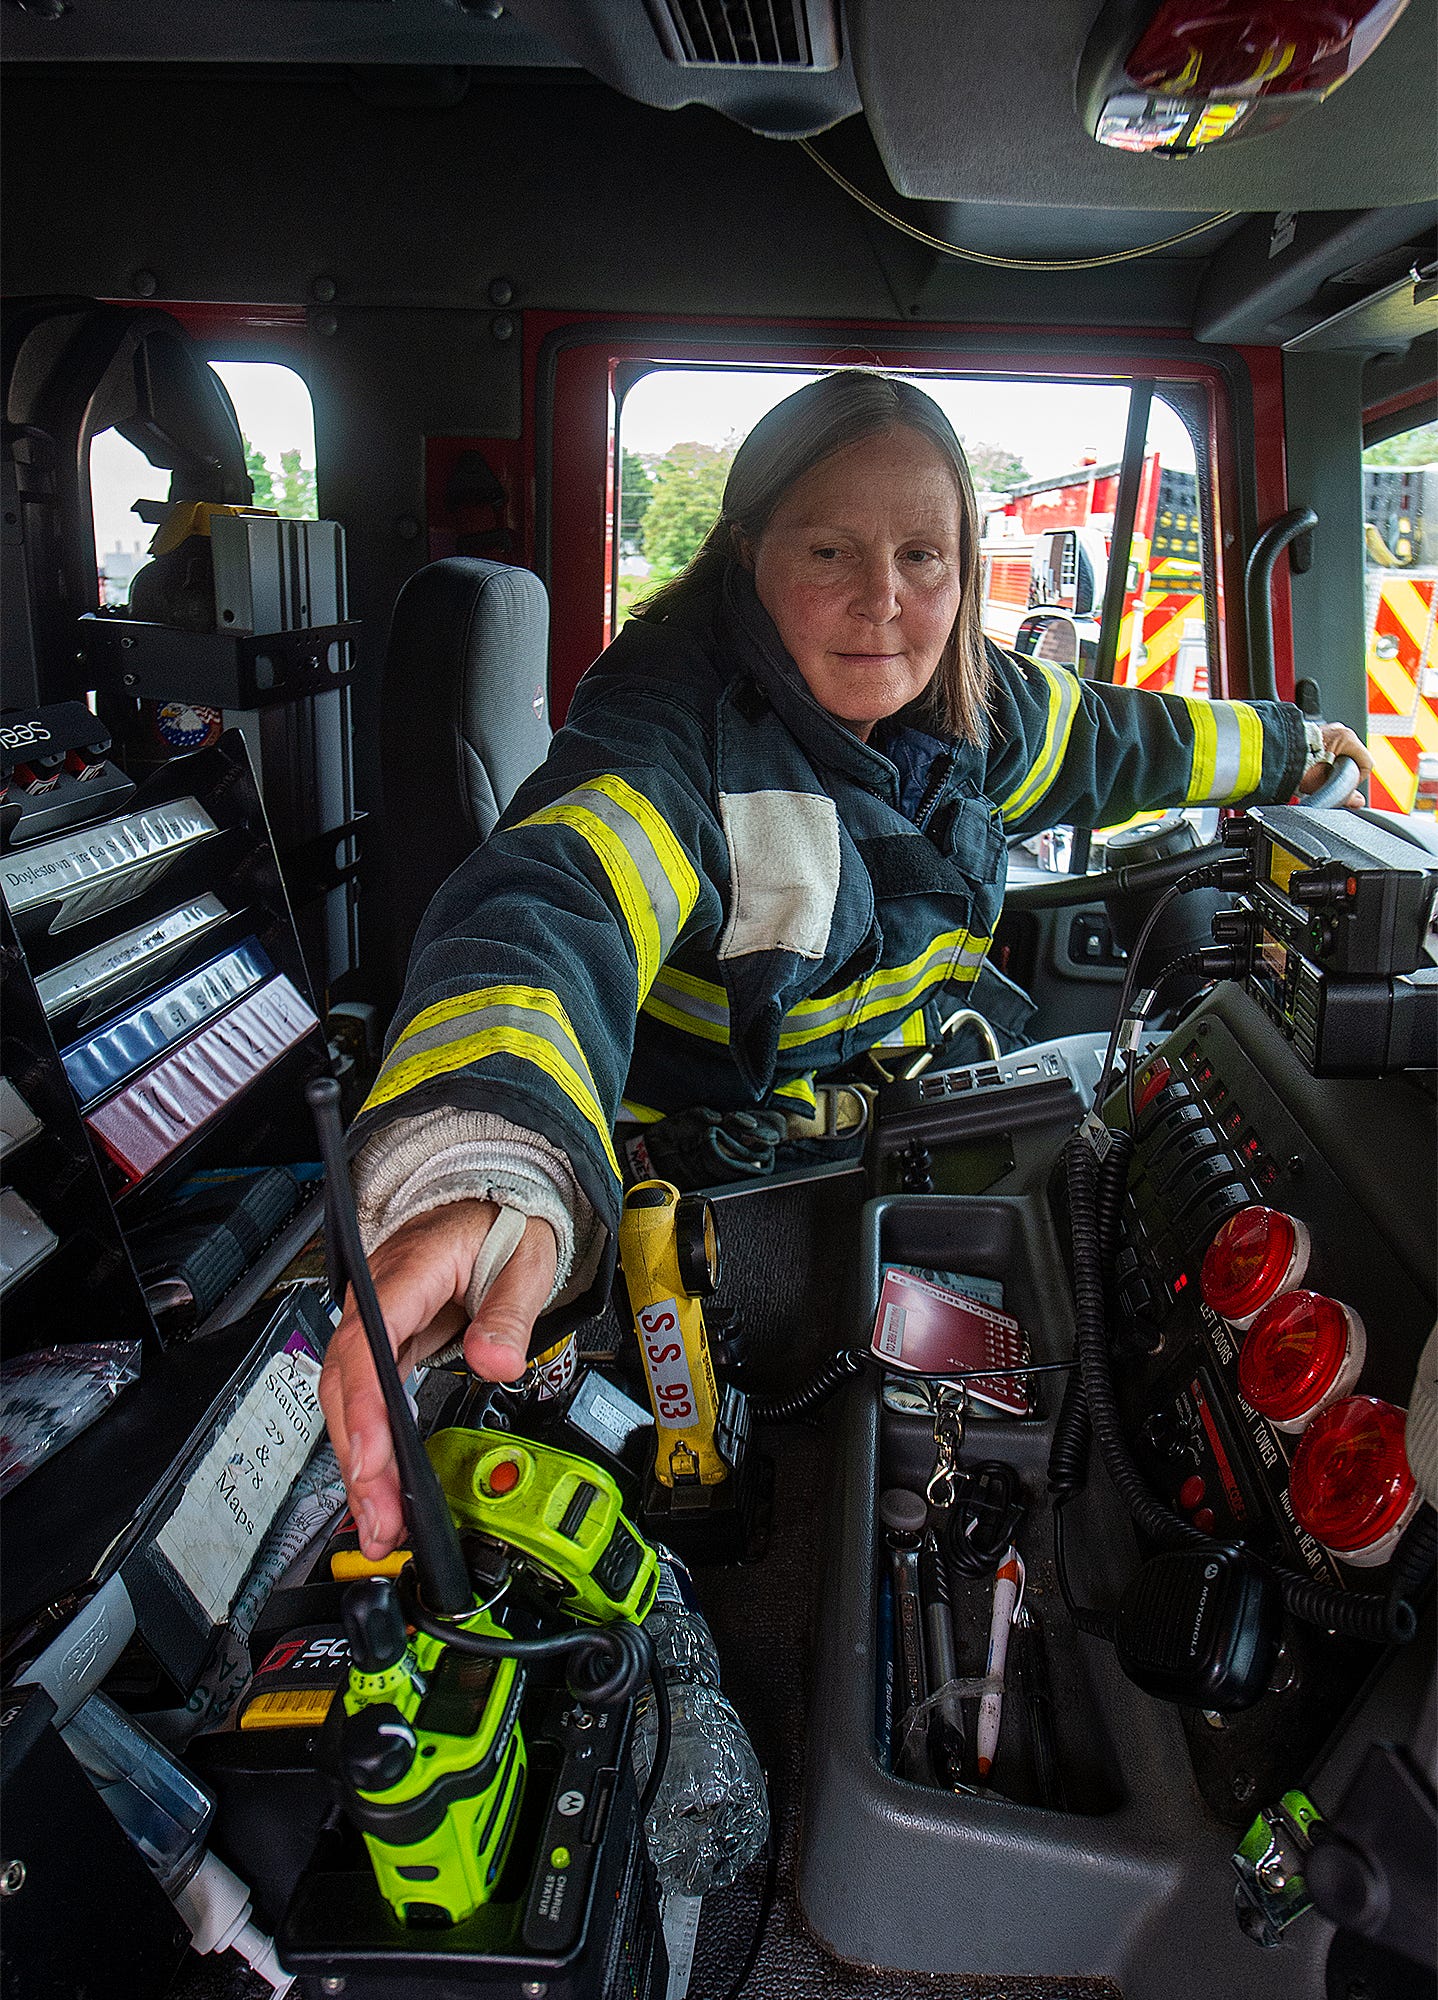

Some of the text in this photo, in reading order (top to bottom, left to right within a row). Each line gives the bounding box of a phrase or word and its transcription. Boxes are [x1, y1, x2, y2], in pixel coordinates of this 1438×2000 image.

[6, 858, 71, 887] Doylestown
[170, 1008, 187, 1028] 15
[965, 1302, 1015, 1328] SPECIAL
[1199, 1302, 1234, 1367] LEFT DOORS
[280, 1364, 320, 1413] NEW
[641, 1310, 692, 1420] S.S. 93
[265, 1373, 311, 1444] Station
[265, 1419, 285, 1446] 29
[255, 1444, 271, 1468] &
[1250, 1416, 1278, 1470] TOWER
[215, 1469, 255, 1536] Maps
[1189, 1586, 1210, 1657] MOTOROLA
[302, 1638, 352, 1659] SC
[538, 1874, 556, 1916] STATUS
[549, 1875, 568, 1923] CHARGE
